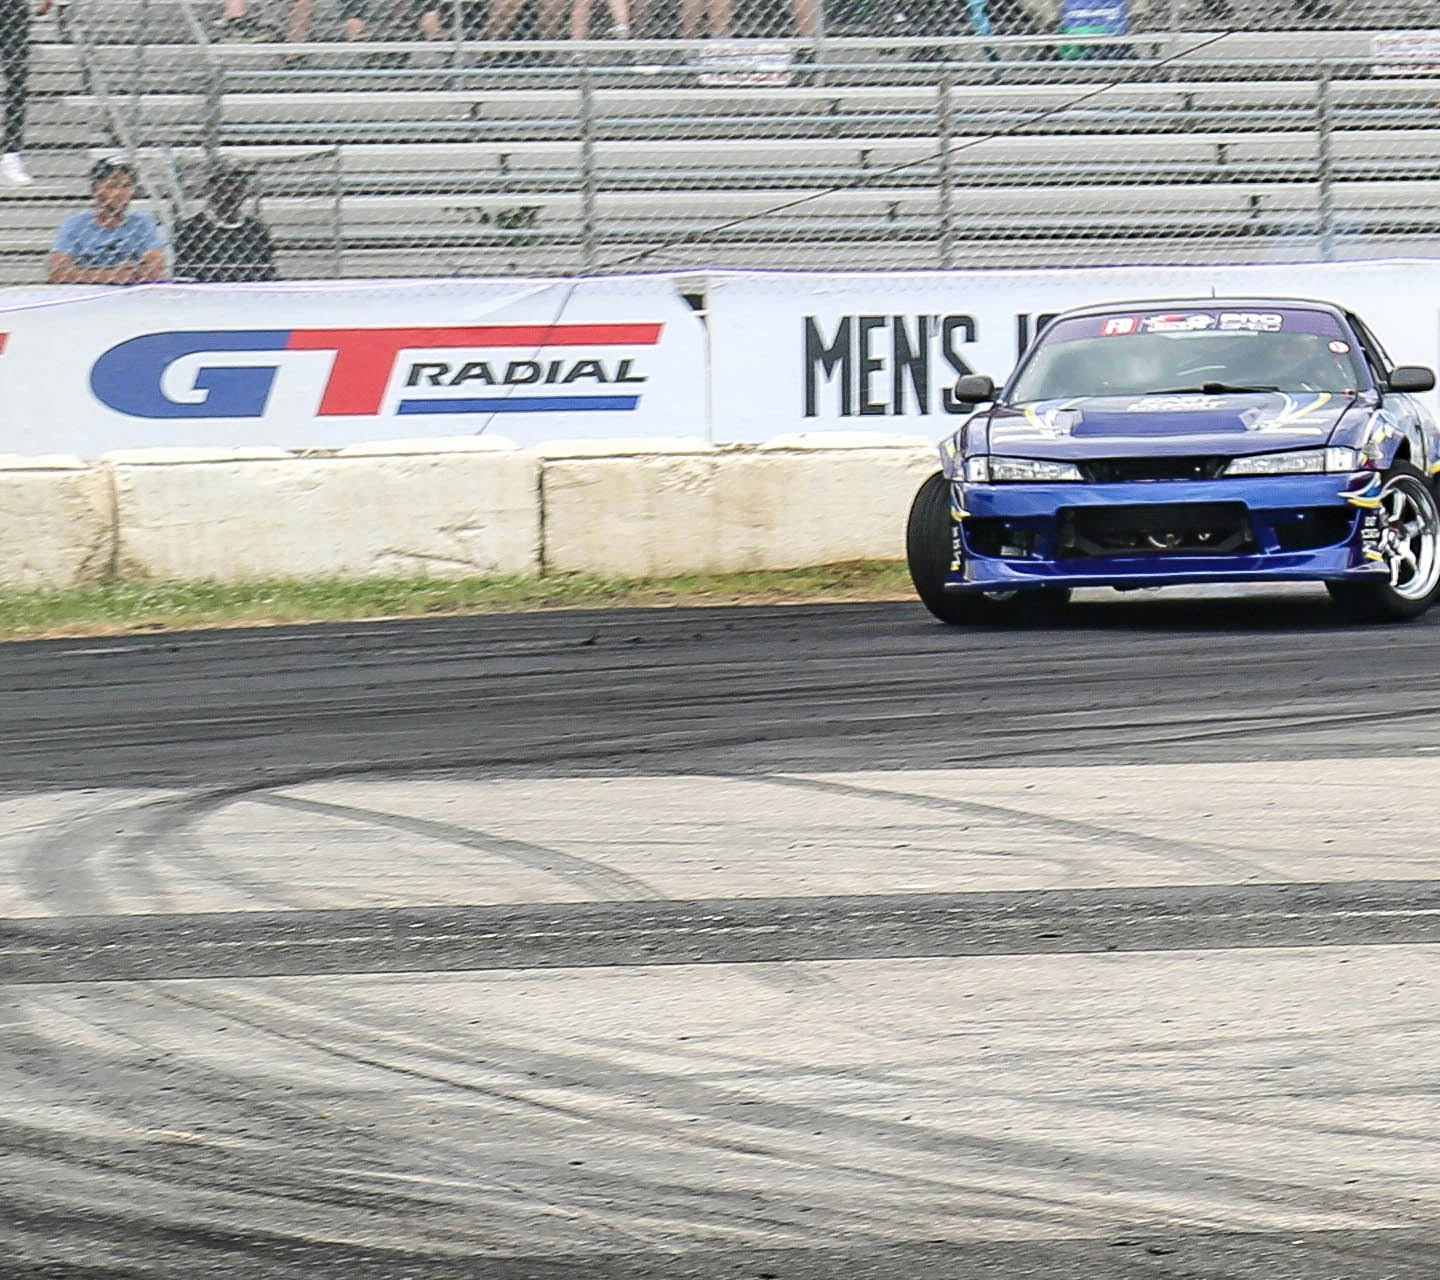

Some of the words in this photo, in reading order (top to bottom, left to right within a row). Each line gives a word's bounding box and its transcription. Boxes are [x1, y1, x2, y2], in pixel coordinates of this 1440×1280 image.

[89, 321, 666, 419] GT
[404, 358, 648, 388] RADIAL
[804, 314, 979, 417] MEN'S
